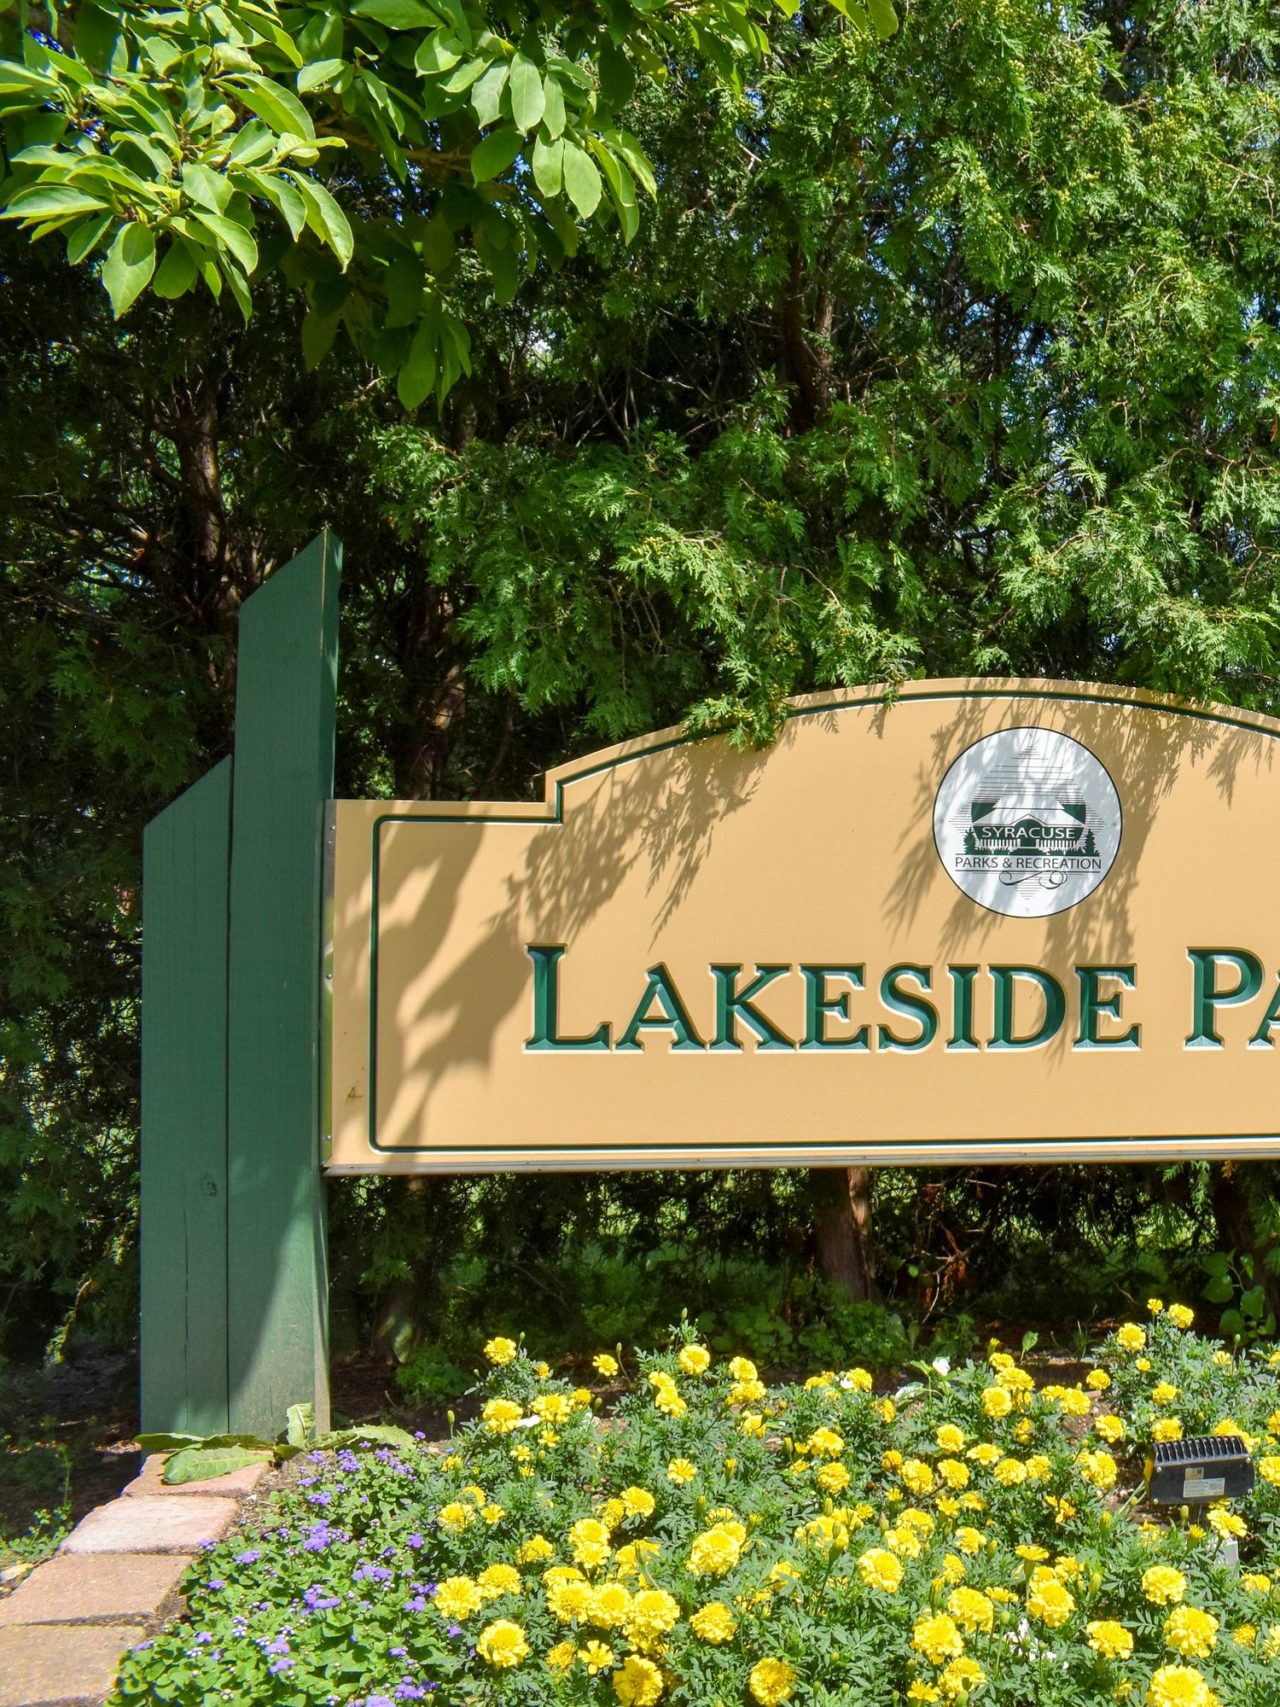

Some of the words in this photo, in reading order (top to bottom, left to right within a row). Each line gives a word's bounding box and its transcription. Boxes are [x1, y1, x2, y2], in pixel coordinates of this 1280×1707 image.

[981, 826, 1076, 839] SYRACUSE
[955, 857, 998, 869] PARKS
[1002, 857, 1013, 869] &
[1016, 857, 1102, 870] RECREATION
[522, 943, 1142, 1055] LAKESIDE
